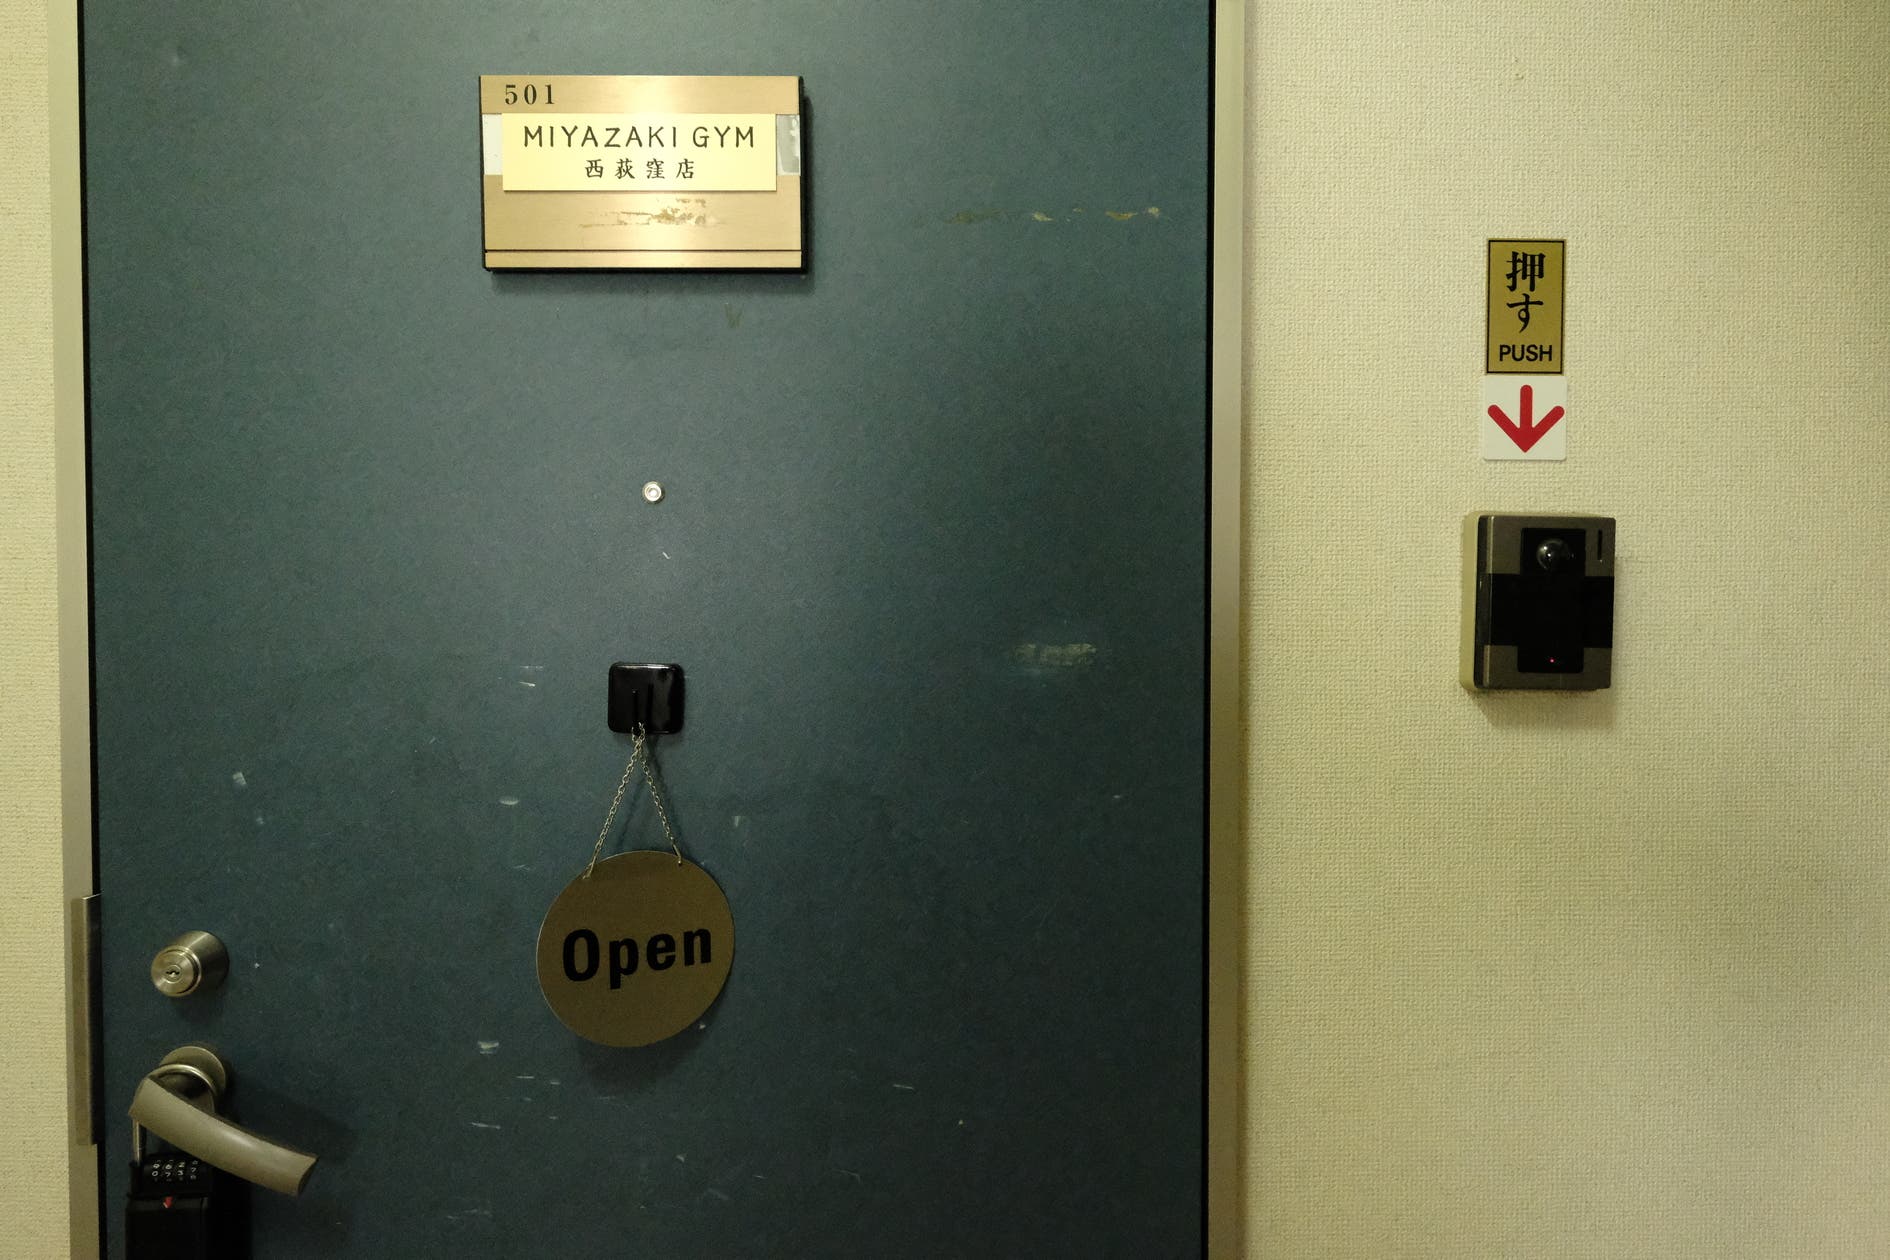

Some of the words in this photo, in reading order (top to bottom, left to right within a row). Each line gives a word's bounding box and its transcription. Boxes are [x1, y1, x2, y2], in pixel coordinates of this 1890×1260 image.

[504, 84, 555, 105] 501
[523, 125, 677, 148] MIYAZAKI
[692, 125, 754, 148] GYM
[584, 157, 695, 180] 西荻窪店
[1505, 250, 1546, 333] 押す
[1499, 344, 1553, 362] PUSH
[562, 928, 712, 990] Open
